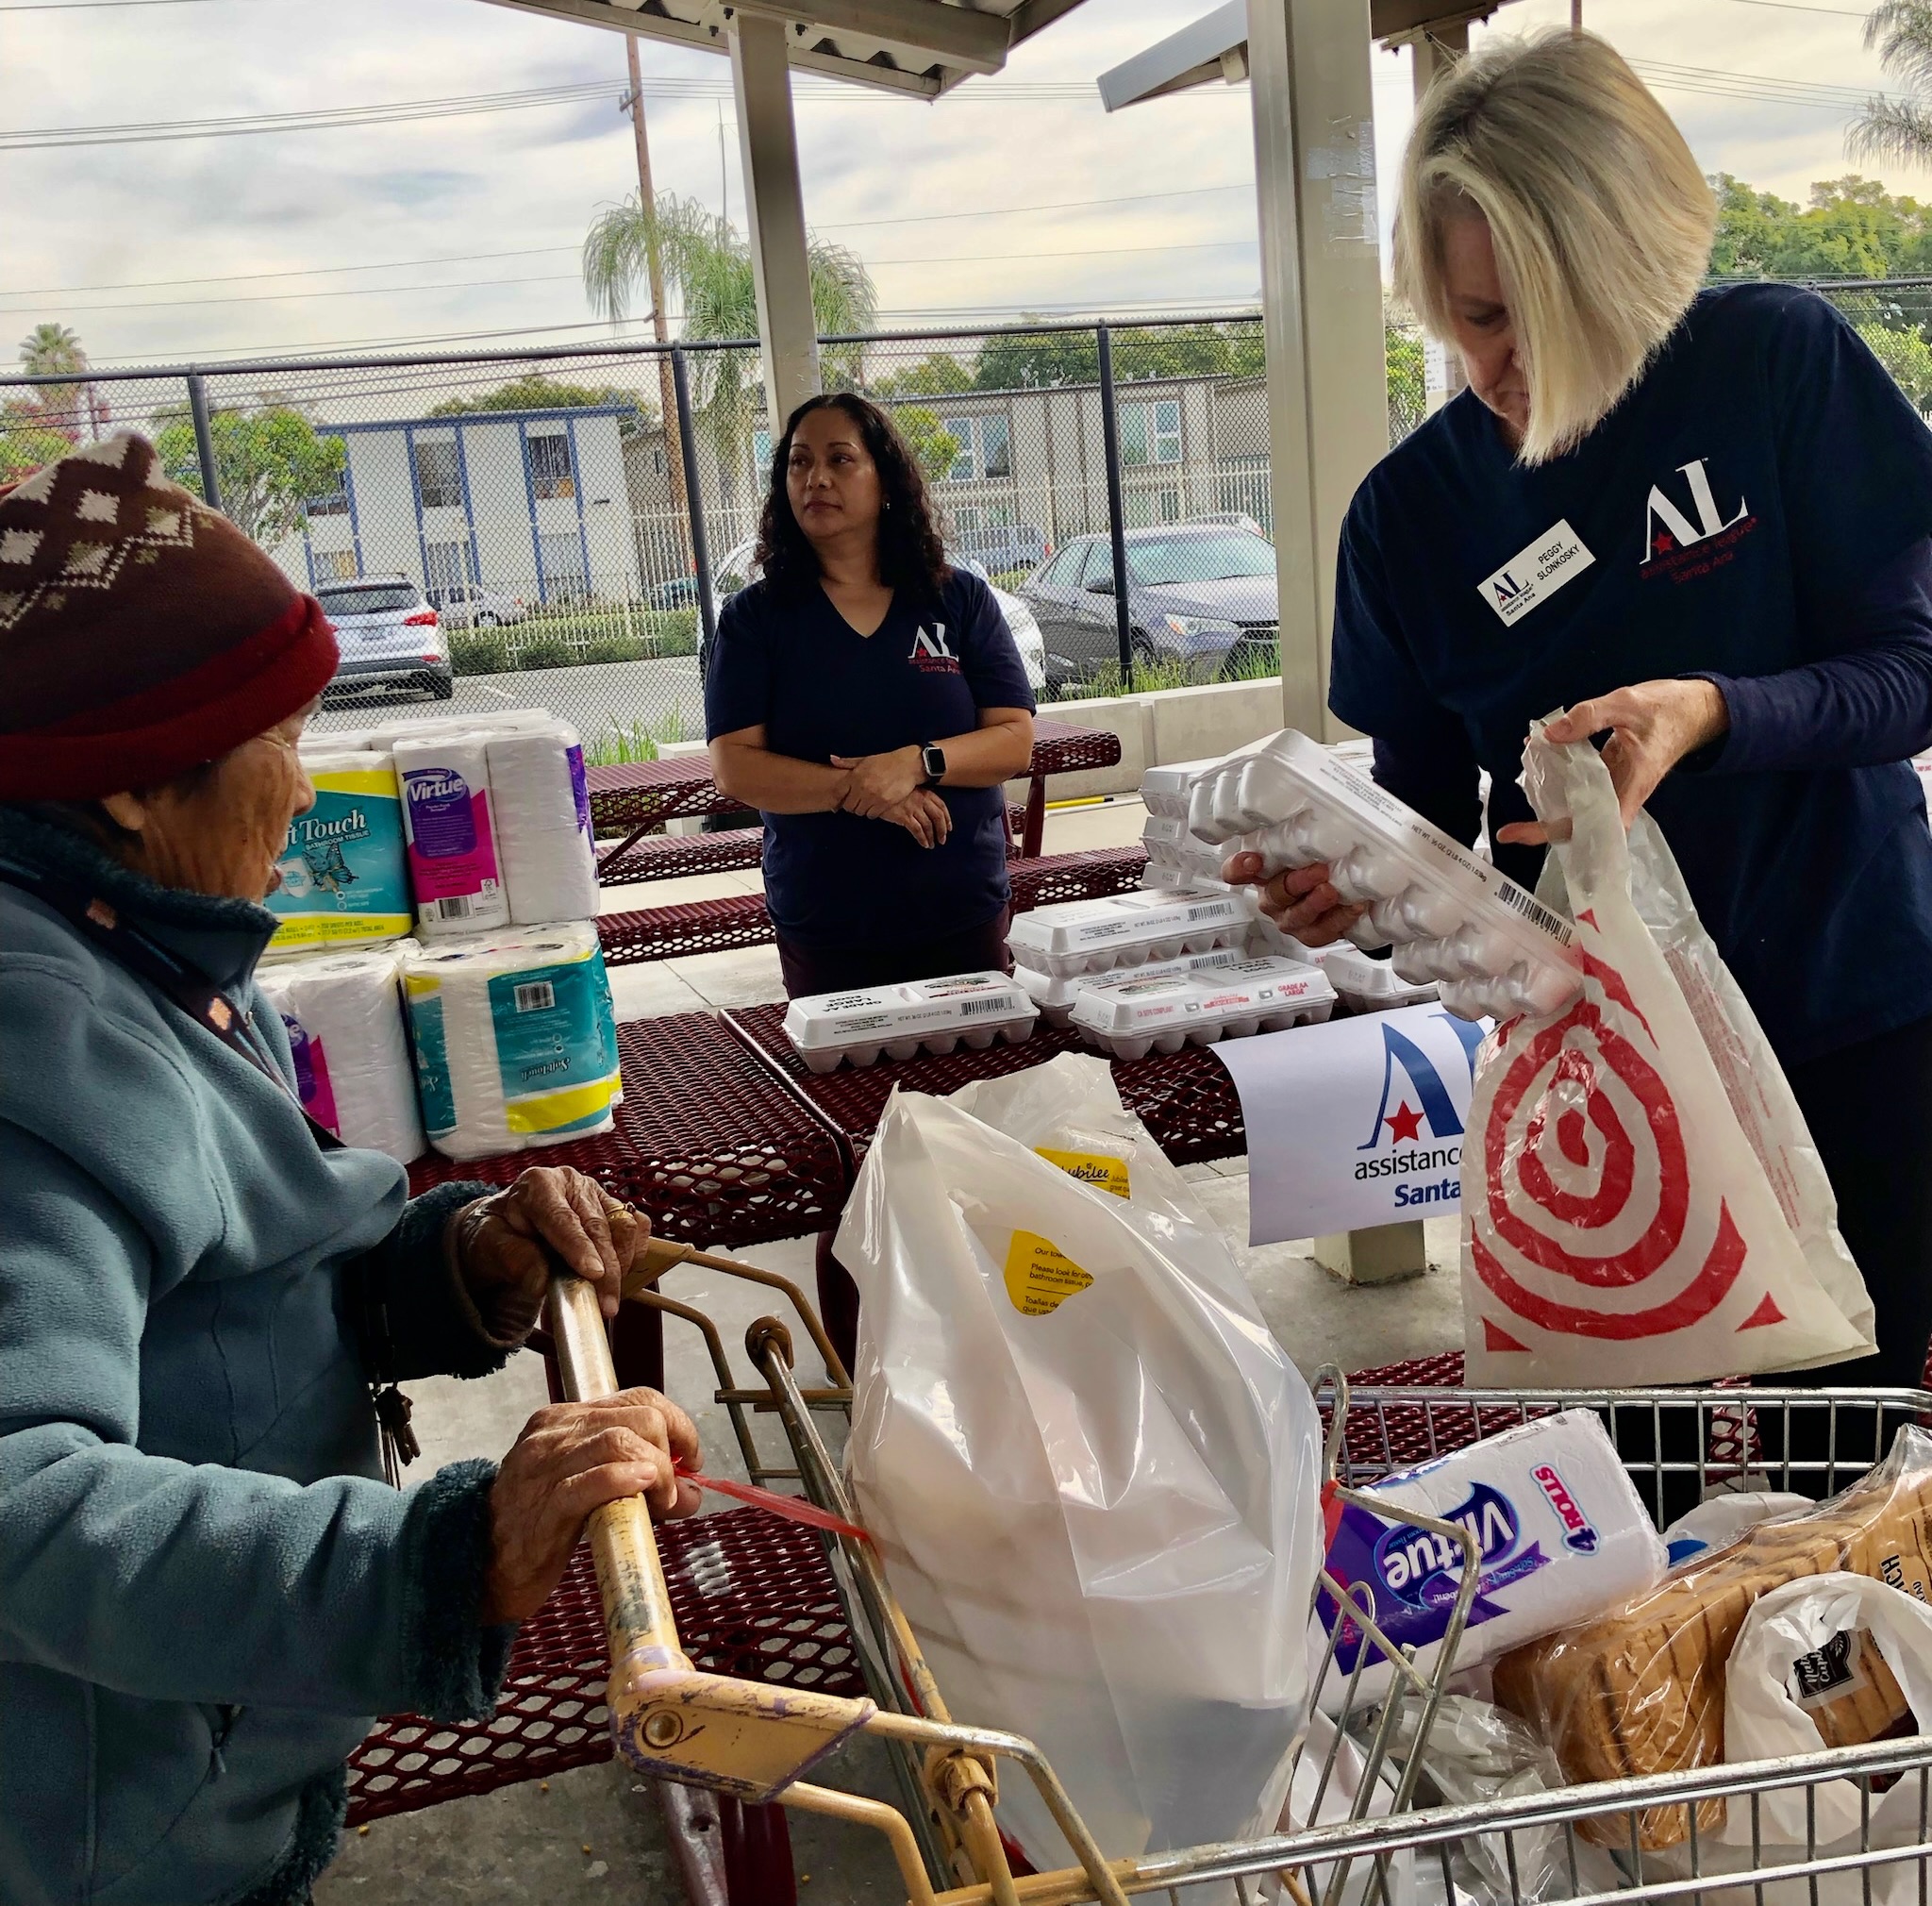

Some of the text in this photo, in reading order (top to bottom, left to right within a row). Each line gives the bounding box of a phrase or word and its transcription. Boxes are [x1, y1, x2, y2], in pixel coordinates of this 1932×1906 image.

[1640, 458, 1748, 564] AL
[1537, 543, 1580, 580] SLONKOSKY
[1538, 541, 1563, 564] PEGGY
[1493, 570, 1529, 608] AL
[1506, 592, 1536, 616] Santa Ana
[908, 622, 959, 662] AL
[410, 778, 464, 801] Virtue
[299, 809, 367, 842] Touch
[1411, 824, 1422, 836] NET
[1278, 983, 1297, 992] GRADE
[826, 997, 871, 1008] LARGE
[1061, 1162, 1109, 1179] ubilee
[1355, 1148, 1463, 1180] assistanc
[1394, 1179, 1461, 1208] Santa
[1029, 1272, 1063, 1283] bathroom
[1031, 1263, 1054, 1273] Please
[1025, 1296, 1048, 1306] Toallas
[1535, 1465, 1585, 1530] ROLLS
[1566, 1527, 1598, 1552] 4
